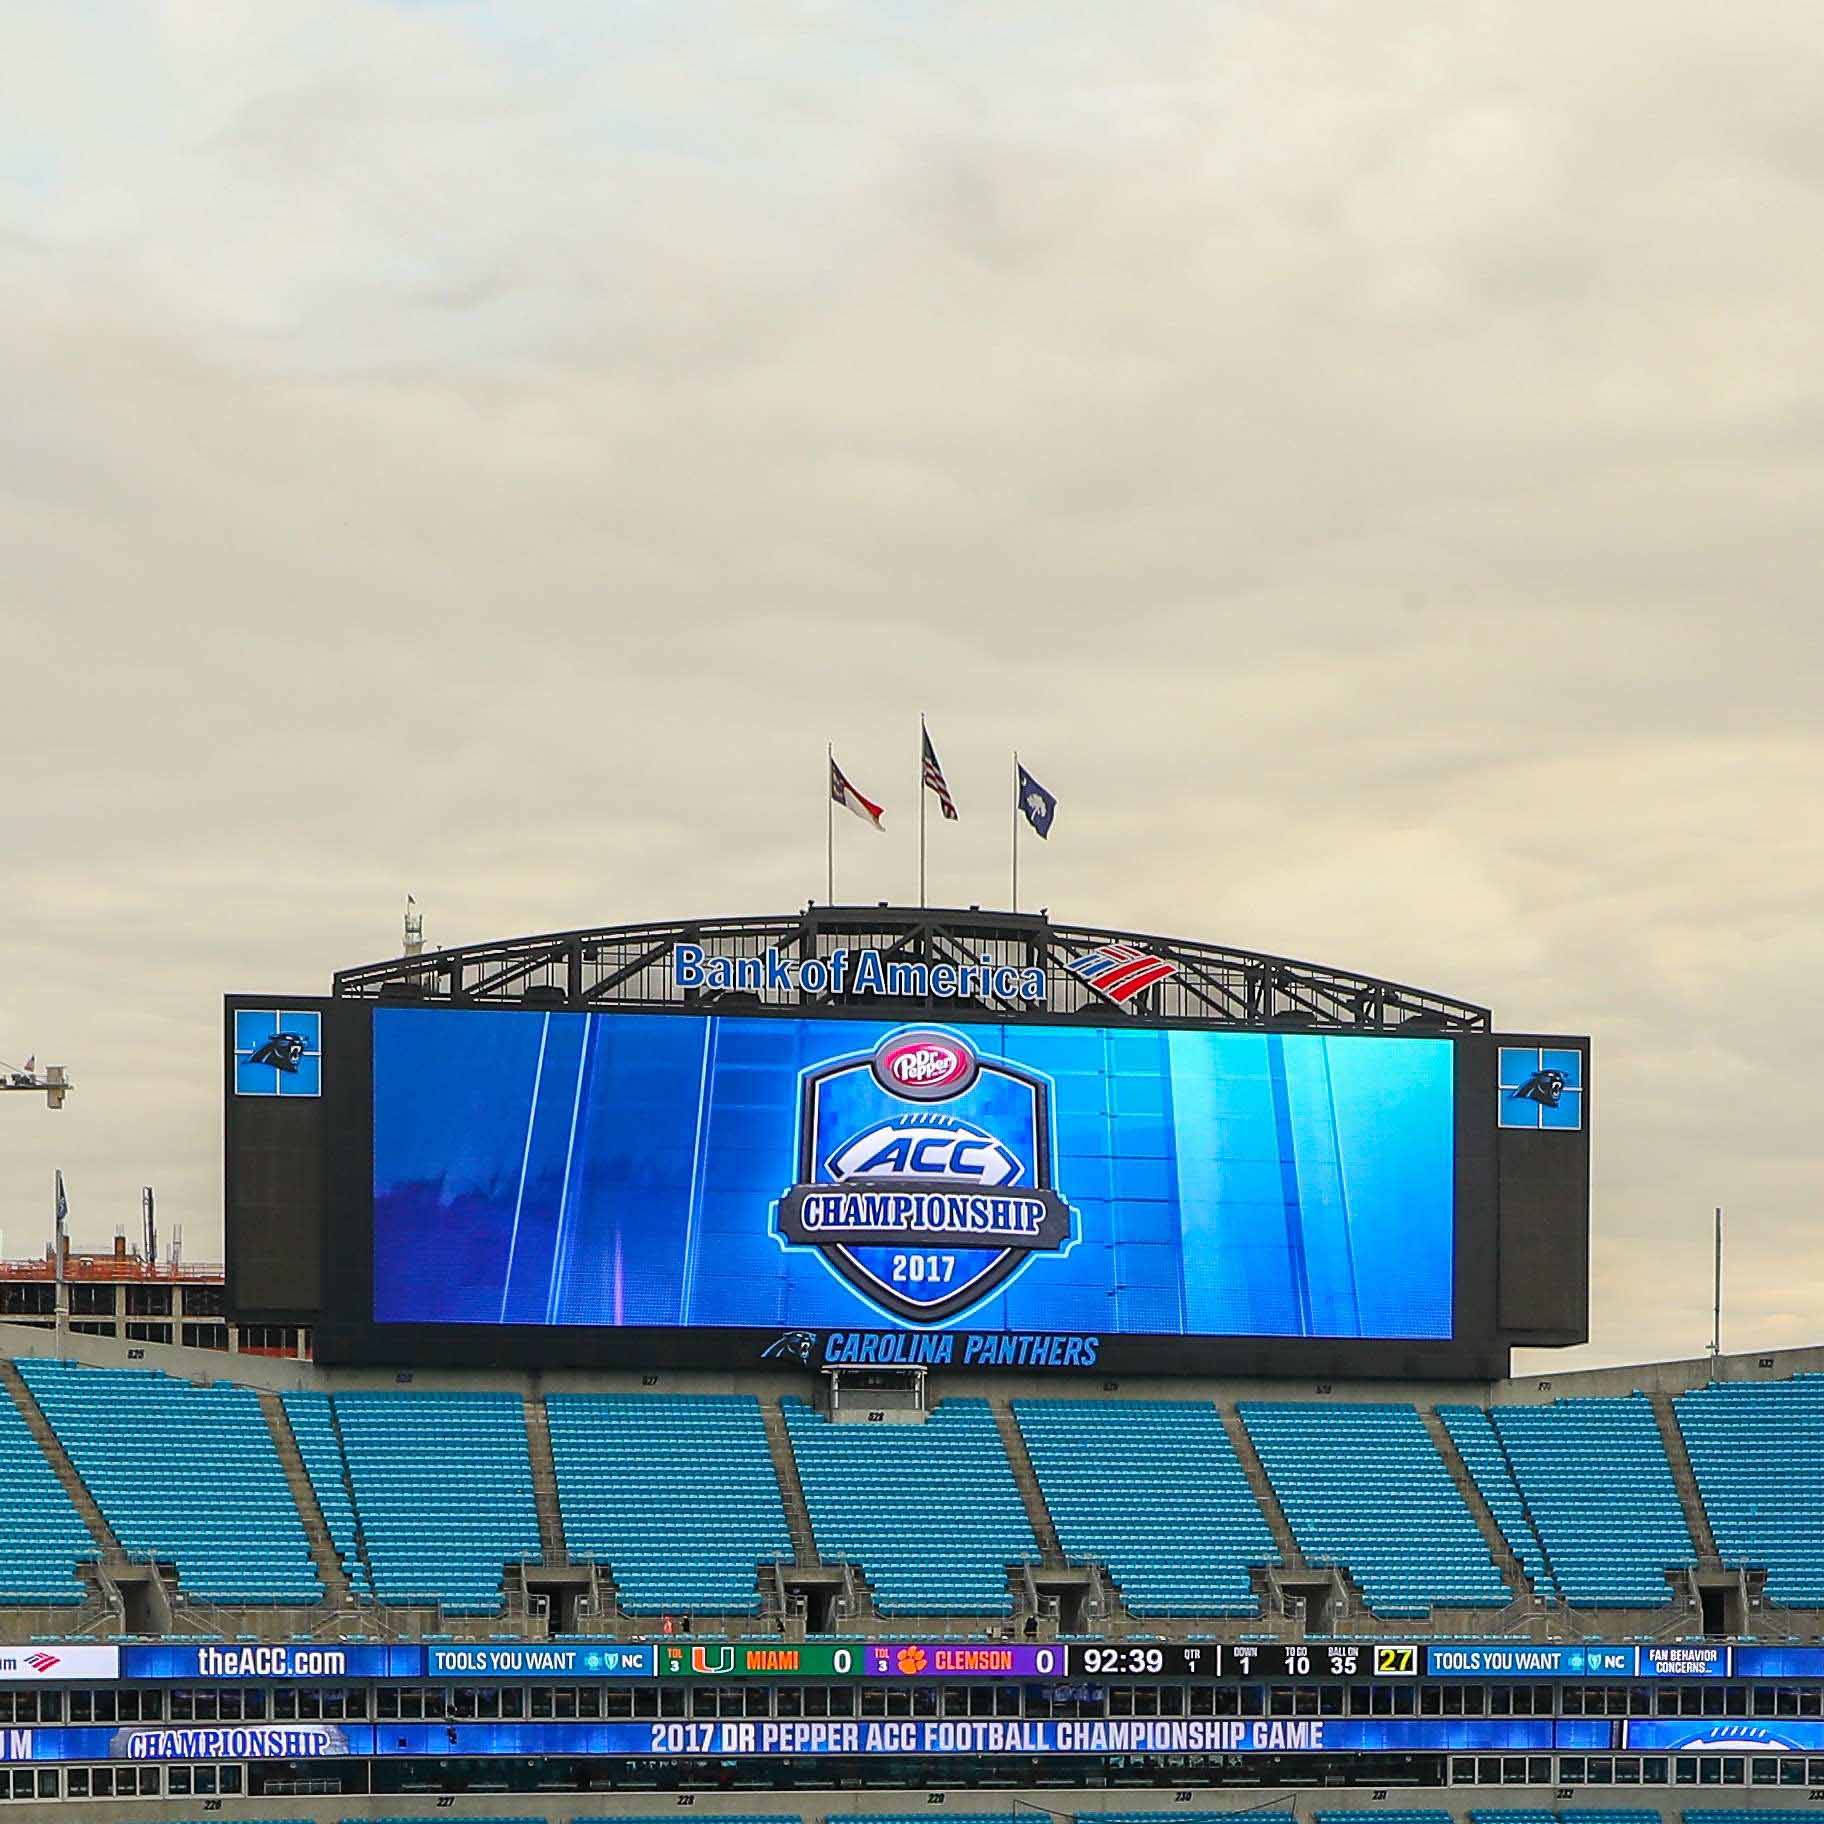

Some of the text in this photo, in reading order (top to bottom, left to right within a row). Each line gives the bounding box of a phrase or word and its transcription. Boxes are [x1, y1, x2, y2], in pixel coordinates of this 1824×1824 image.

[674, 944, 1047, 1001] Bank of America
[893, 1055, 953, 1081] Pepper
[854, 1136, 996, 1174] ACC
[802, 1193, 1046, 1235] CHAMPIONSHIP
[892, 1255, 955, 1282] 2017
[825, 1333, 1099, 1367] CAROLINA PANTHERS
[198, 1647, 345, 1676] theACC.com
[436, 1652, 576, 1671] TOOLS YOU WANT
[746, 1651, 800, 1671] MIAMI
[833, 1649, 852, 1673] 0
[935, 1651, 1012, 1670] CLEMSON
[1035, 1649, 1054, 1673] 0
[1083, 1649, 1164, 1673] 92:39
[1184, 1649, 1201, 1661] QTR
[1233, 1647, 1258, 1657] DOWN
[1328, 1647, 1345, 1657] BALL
[1379, 1649, 1413, 1672] 27
[1434, 1652, 1561, 1670] TOOLS YOU WANT
[1649, 1649, 1717, 1662] FAN BEHAVIOR
[621, 1655, 643, 1669] NC
[670, 1661, 680, 1672] 3
[878, 1660, 888, 1672] 3
[1188, 1661, 1195, 1673] 1
[1240, 1657, 1249, 1675] 1
[1285, 1657, 1310, 1675] 10
[1330, 1656, 1358, 1675] 35
[1605, 1655, 1625, 1669] NC
[128, 1729, 330, 1758] CHAMPIONSHIP
[651, 1722, 1324, 1753] 2017 DR PEPPER ACC FOOTBALL CHAMPIONSHIP GAME
